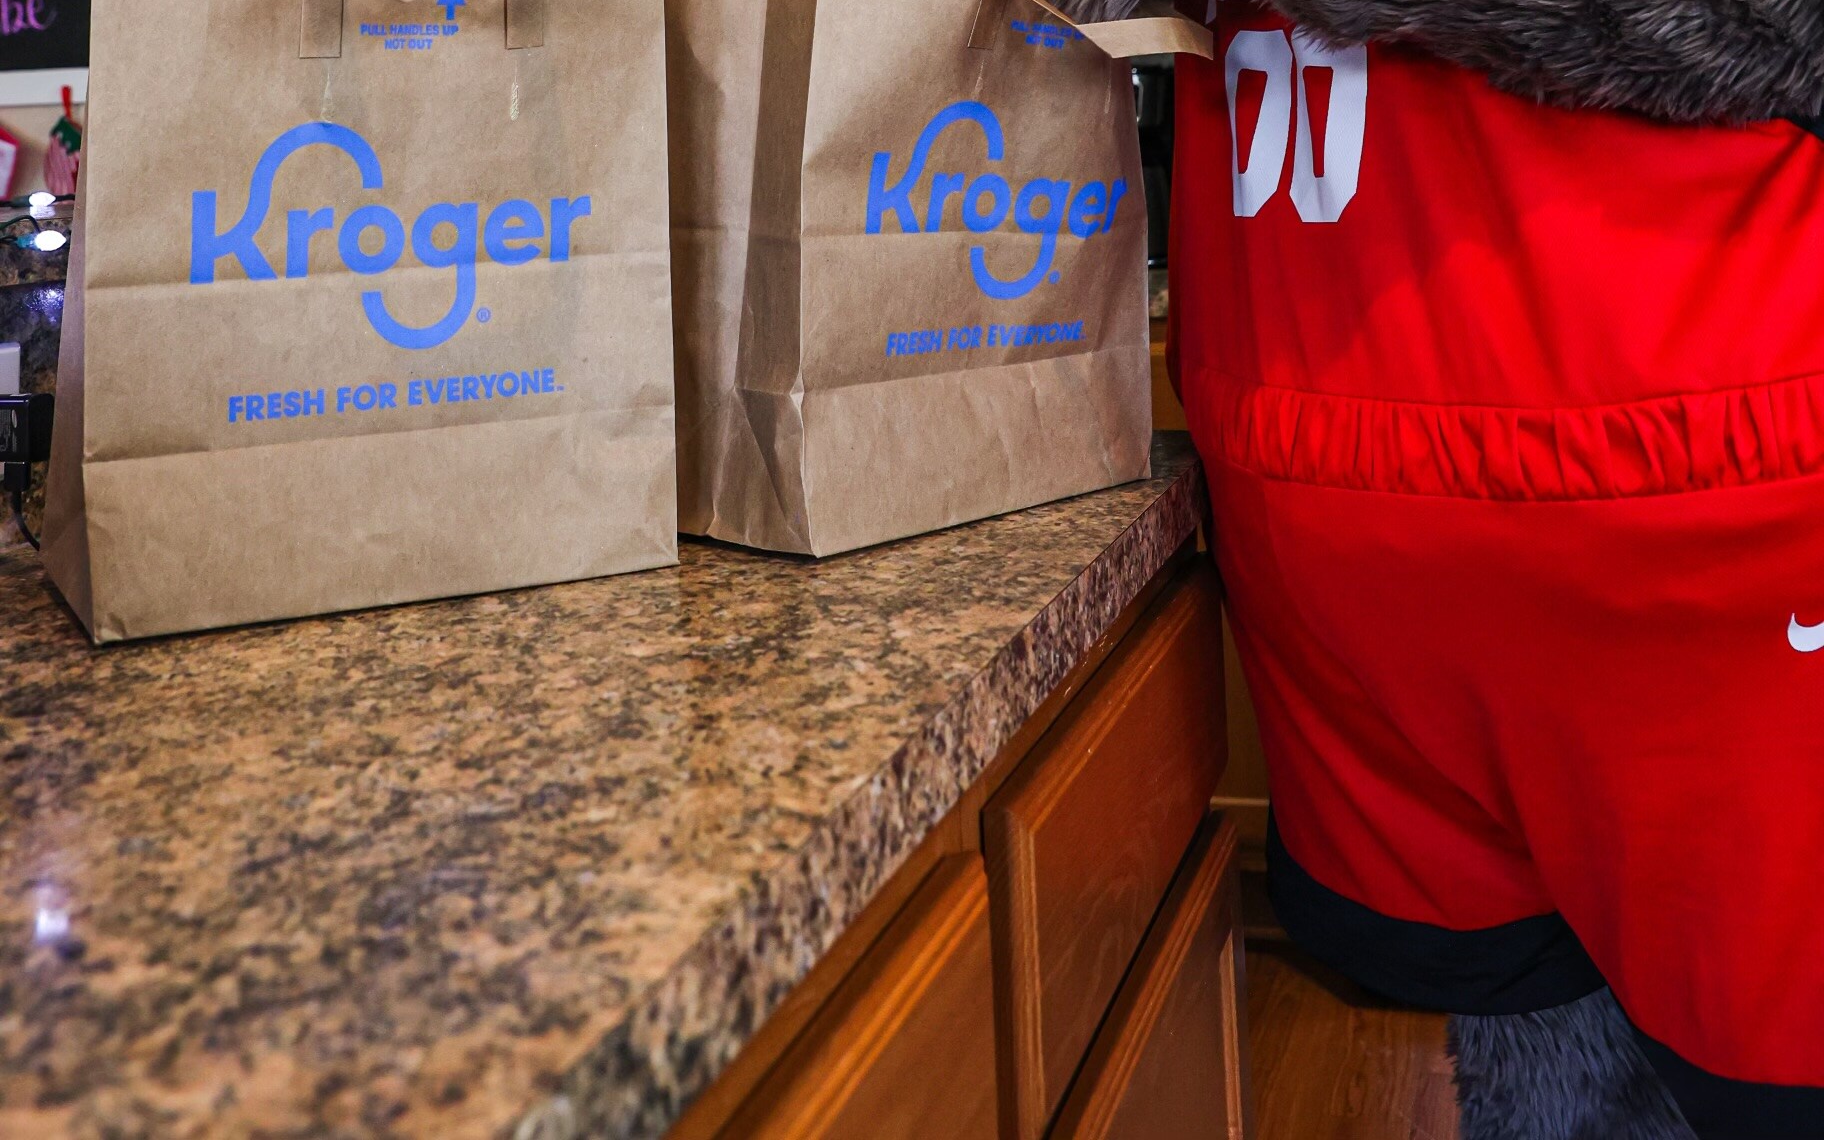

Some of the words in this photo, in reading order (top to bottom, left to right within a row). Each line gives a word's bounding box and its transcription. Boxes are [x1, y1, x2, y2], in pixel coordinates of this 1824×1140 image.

[359, 23, 387, 36] PULL
[389, 24, 440, 36] HANDLES
[442, 24, 459, 36] UP
[384, 38, 406, 50] NOT
[408, 37, 433, 50] OUT
[1224, 24, 1368, 223] 00
[885, 329, 943, 357] FRESH
[947, 325, 984, 350] FOR
[227, 388, 326, 423] FRESH
[336, 382, 398, 413] FOR
